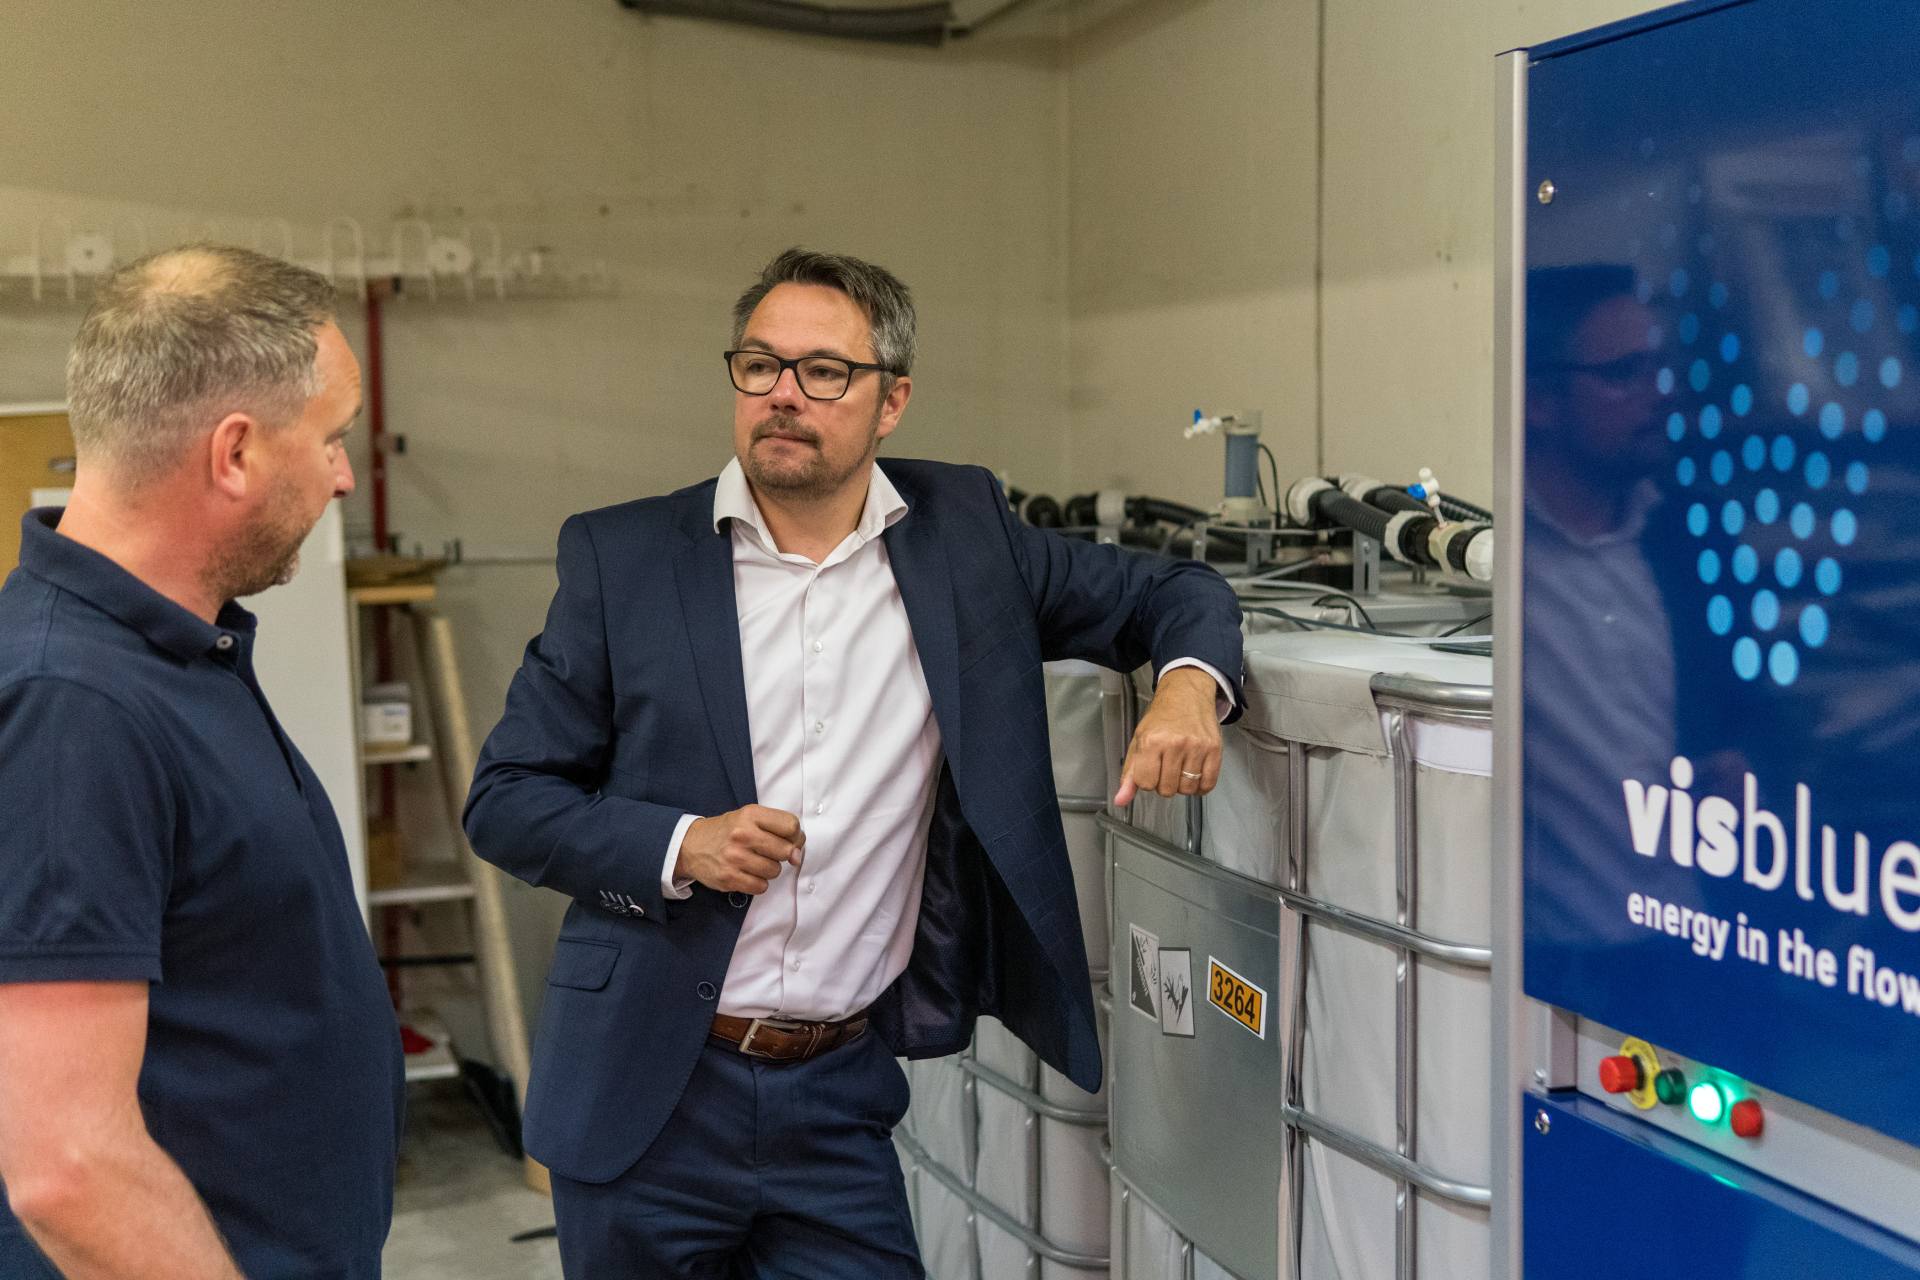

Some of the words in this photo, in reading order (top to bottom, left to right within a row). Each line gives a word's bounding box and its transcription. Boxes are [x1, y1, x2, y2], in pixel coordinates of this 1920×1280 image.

[1623, 756, 1920, 932] visblue
[1627, 892, 1730, 961] energy
[1737, 912, 1769, 965] in
[1779, 928, 1838, 987] the
[1214, 970, 1256, 1024] 3264
